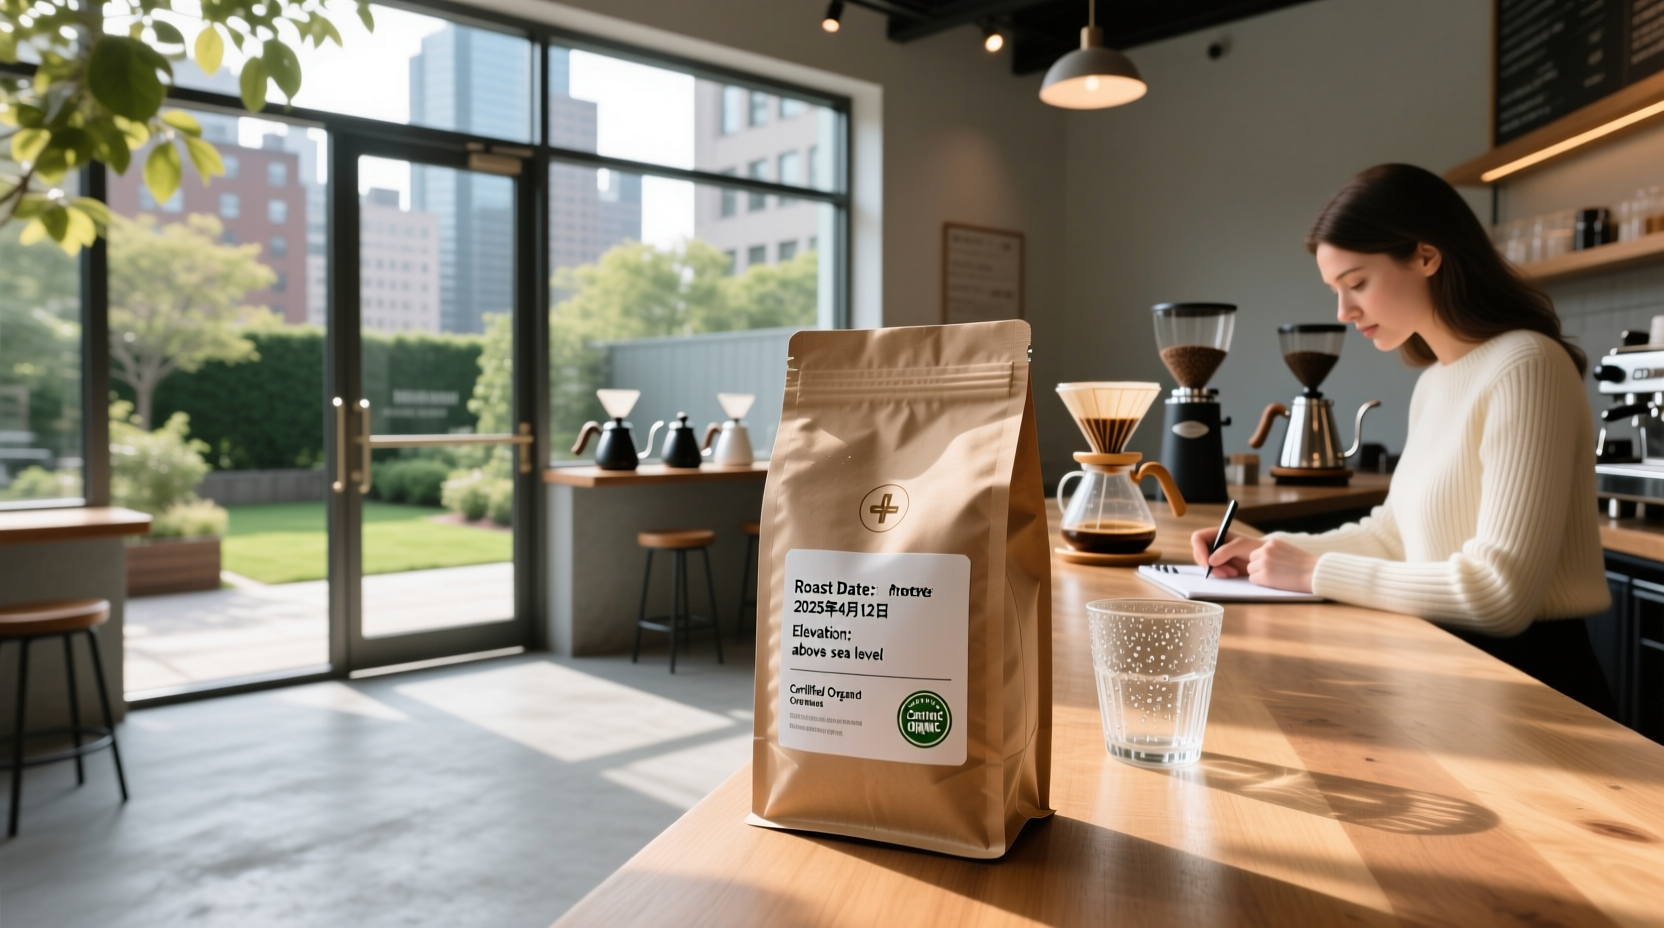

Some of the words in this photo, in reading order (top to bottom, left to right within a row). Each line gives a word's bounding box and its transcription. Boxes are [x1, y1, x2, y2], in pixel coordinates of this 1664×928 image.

[795, 579, 833, 595] Roast
[837, 580, 876, 596] Date:
[793, 600, 889, 619] 2025年4月12日
[792, 623, 852, 641] Elevation:
[831, 648, 851, 659] sea
[855, 646, 884, 661] level
